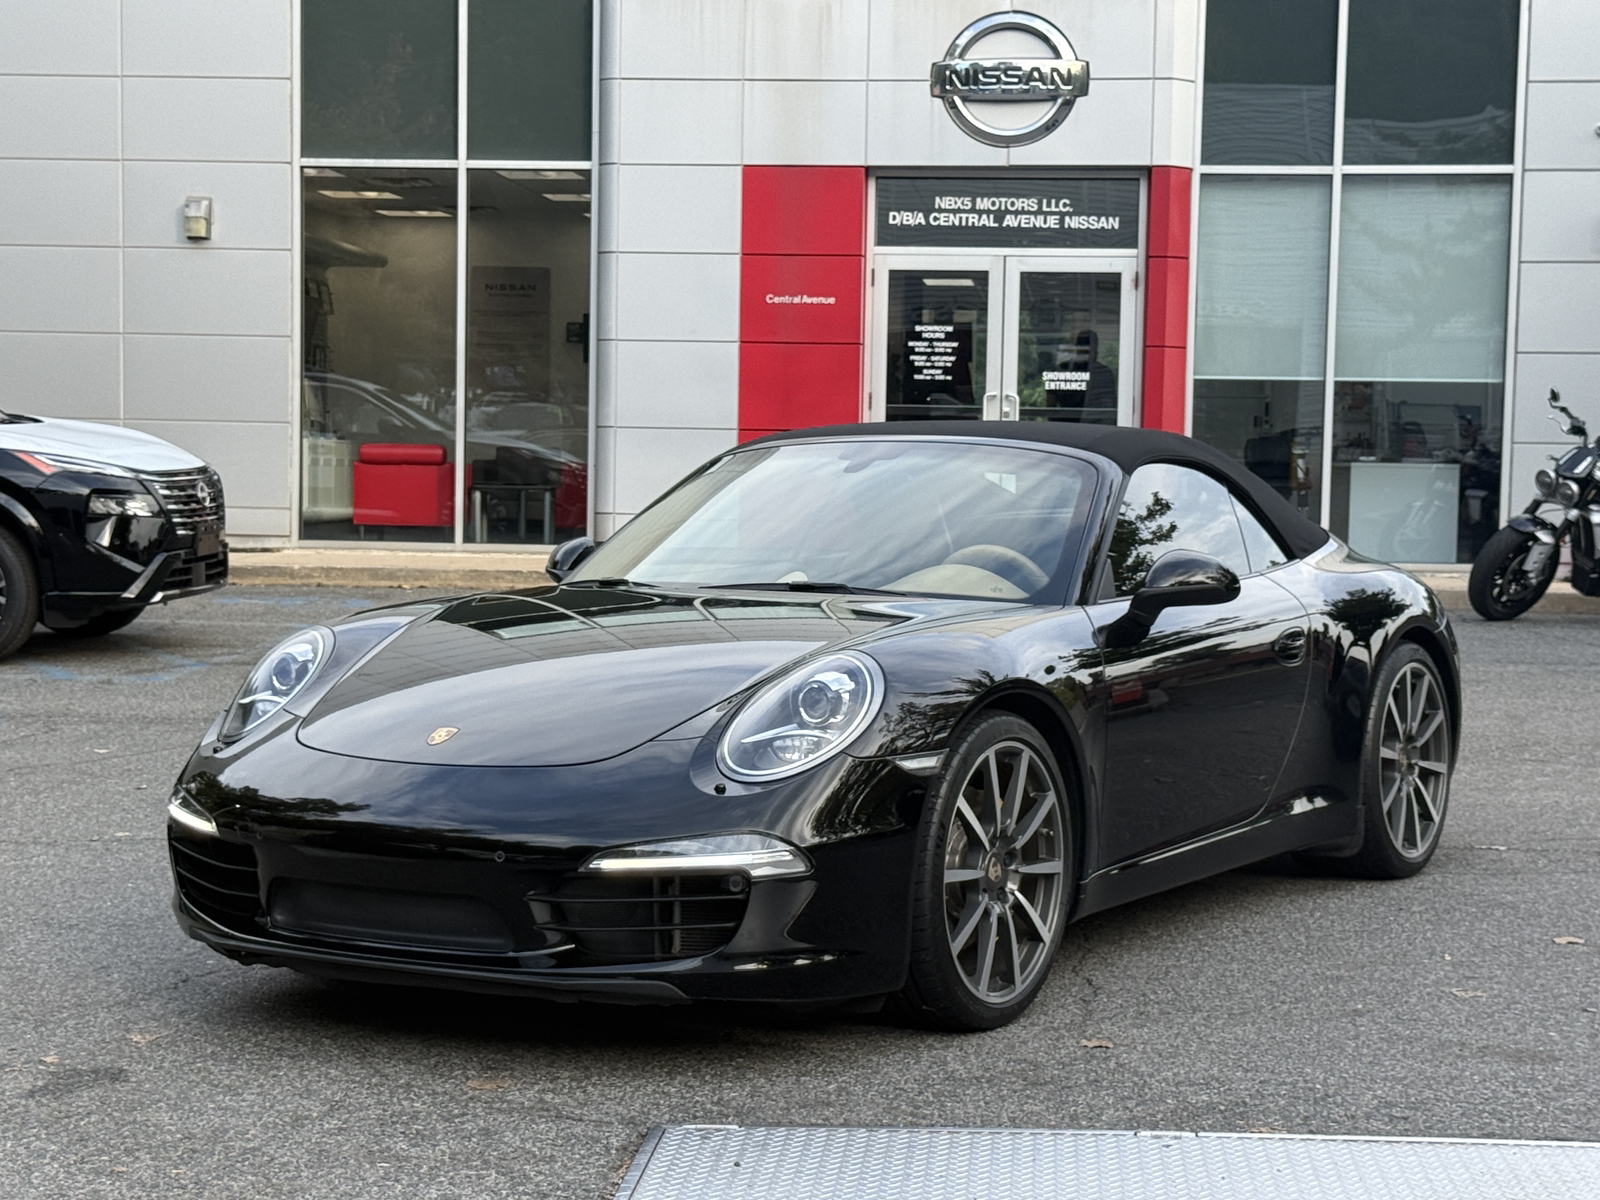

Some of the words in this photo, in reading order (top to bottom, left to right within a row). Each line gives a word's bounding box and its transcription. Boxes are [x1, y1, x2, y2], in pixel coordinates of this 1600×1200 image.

[945, 67, 1074, 90] NISSAN
[934, 197, 972, 210] NBX5
[975, 199, 1037, 212] MOTORS
[1042, 199, 1074, 212] LLC.
[888, 212, 926, 226] D/B/A
[929, 213, 998, 227] CENTRAL
[1002, 215, 1060, 229] AVENUE
[1064, 216, 1120, 230] NISSAN
[484, 283, 537, 292] NISSAN
[765, 294, 801, 304] Central
[802, 295, 836, 304] Avenue
[1042, 371, 1090, 381] SHOWROOM
[1044, 381, 1087, 391] ENTRANCE
